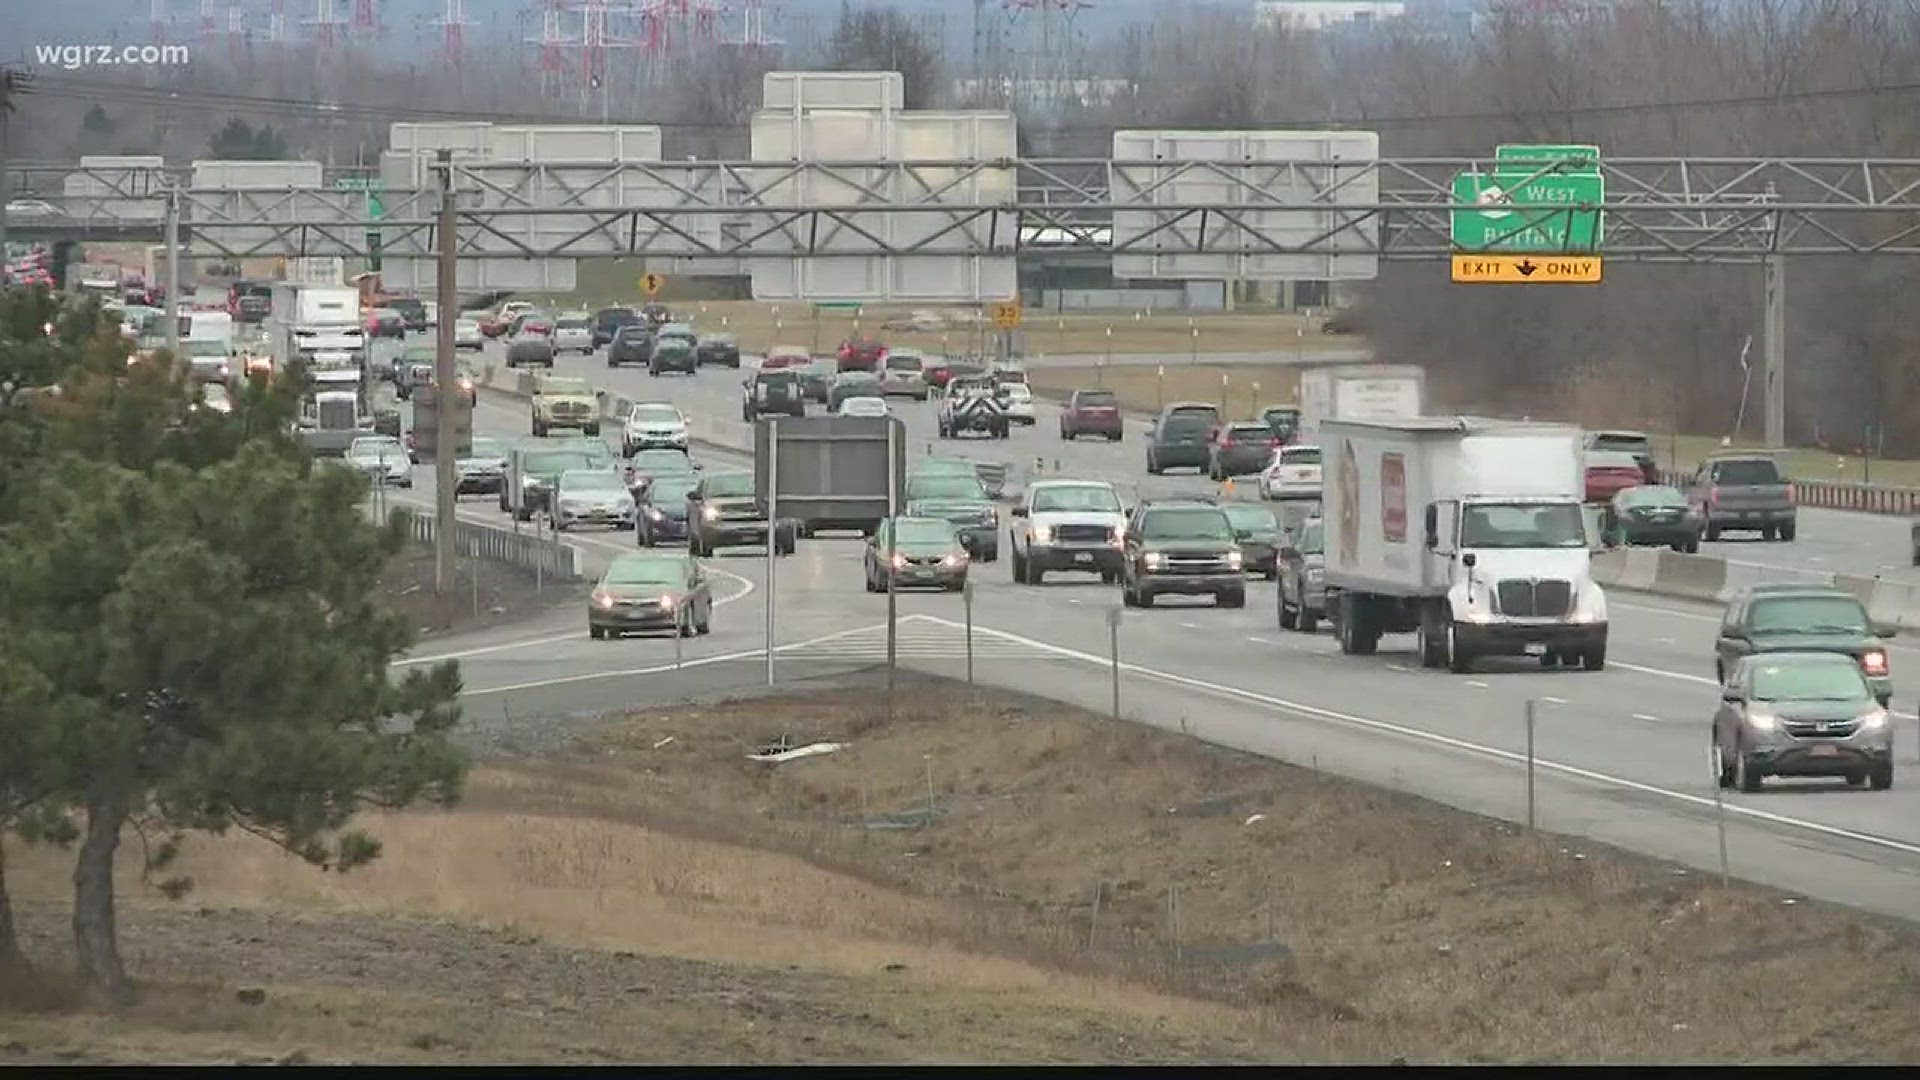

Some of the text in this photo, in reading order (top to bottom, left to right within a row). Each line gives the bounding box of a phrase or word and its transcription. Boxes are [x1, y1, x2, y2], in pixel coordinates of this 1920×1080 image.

[1527, 185, 1577, 201] WEST
[1462, 262, 1592, 275] EXIT ONLY
